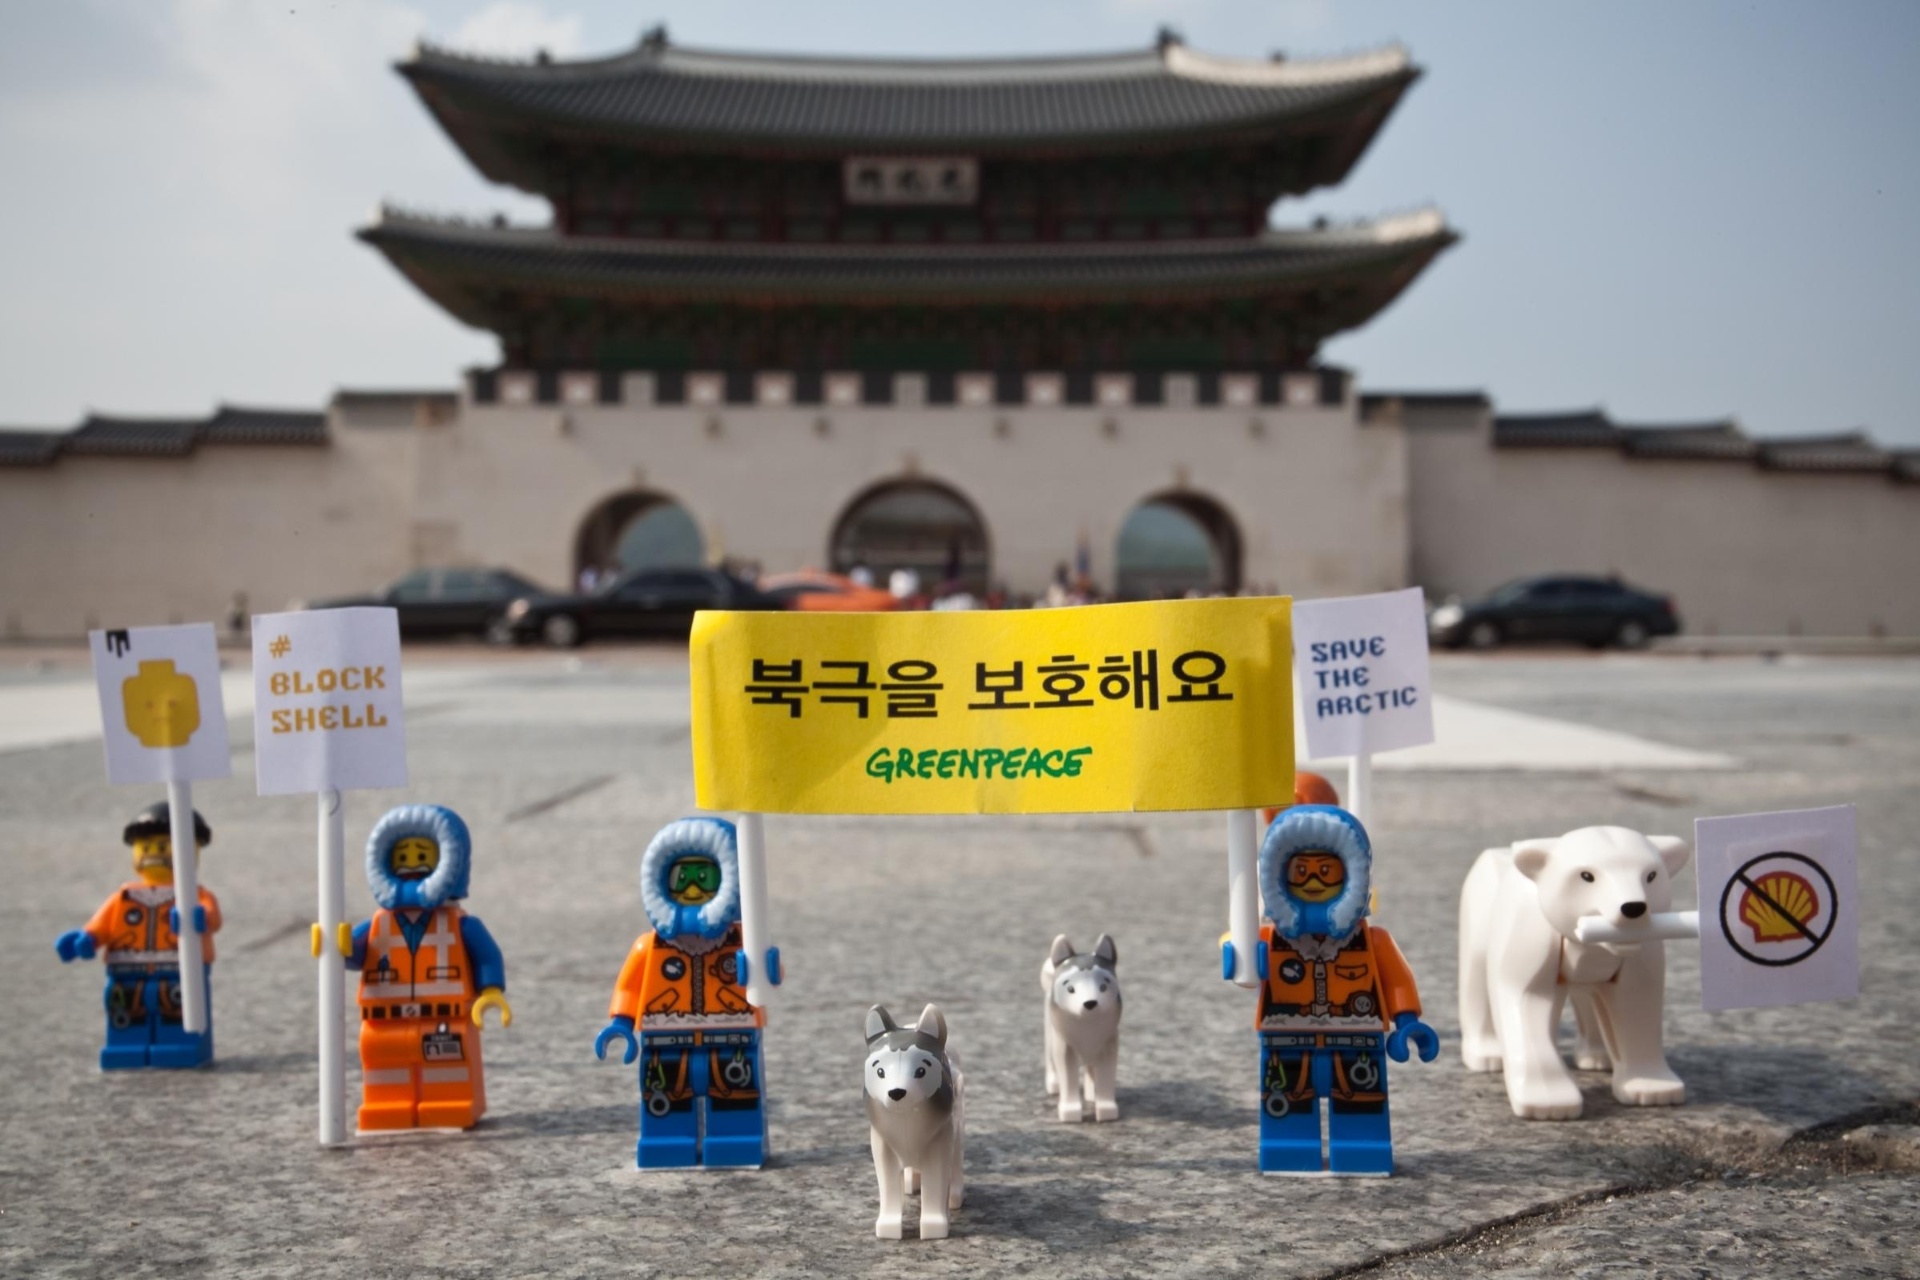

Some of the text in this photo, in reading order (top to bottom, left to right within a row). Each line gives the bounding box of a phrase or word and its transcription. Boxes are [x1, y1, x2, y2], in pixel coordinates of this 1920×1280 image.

[1310, 635, 1386, 664] SAVE
[268, 665, 386, 697] BLOCK
[744, 648, 1234, 719] 북극을 보호해요
[1314, 666, 1371, 690] THE
[1316, 686, 1417, 719] ARCTIC
[270, 703, 388, 735] SHELL
[865, 745, 1094, 784] GREENPEACE
